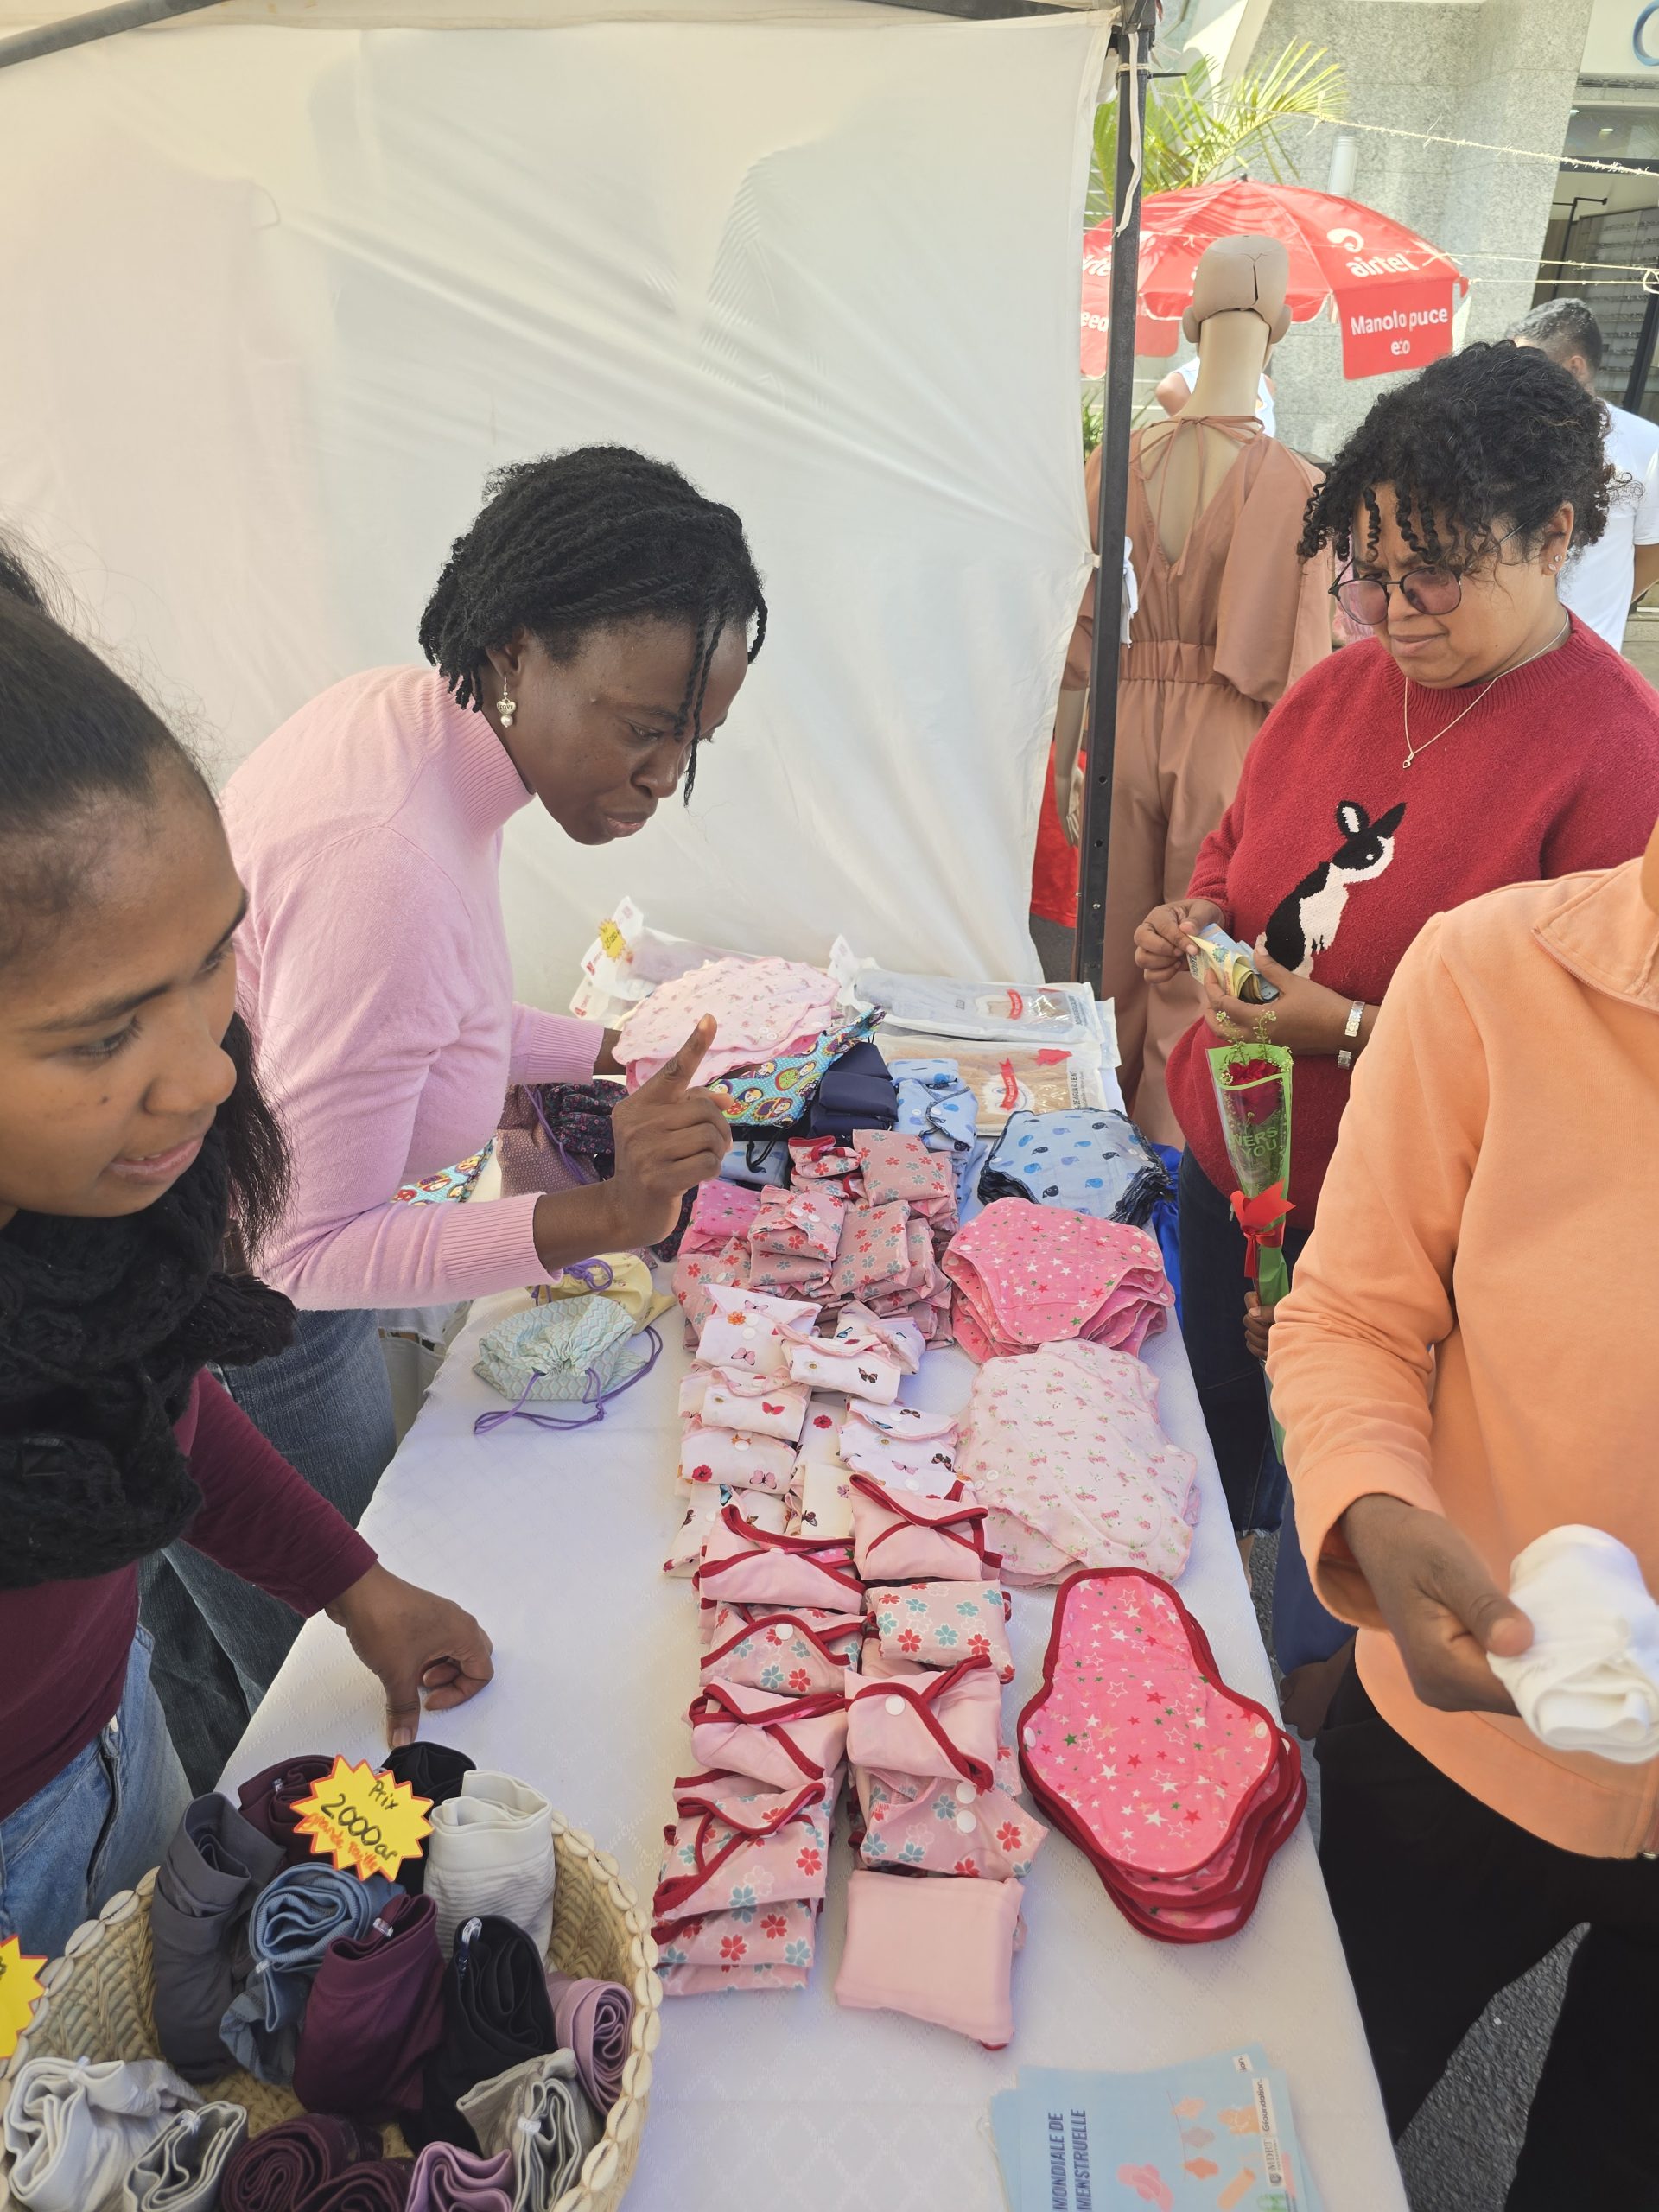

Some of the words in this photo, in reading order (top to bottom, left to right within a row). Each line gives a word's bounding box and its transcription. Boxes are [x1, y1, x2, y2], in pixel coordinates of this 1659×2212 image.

[1345, 253, 1420, 277] airtel
[1351, 310, 1408, 336] Manolo
[1409, 308, 1448, 332] puce
[1241, 1138, 1277, 1157] YOU
[368, 1780, 398, 1811] Prix
[1048, 2112, 1064, 2131] DE
[1049, 2134, 1068, 2211] MONDIALE
[1071, 2108, 1092, 2211] MENSTRUELLE
